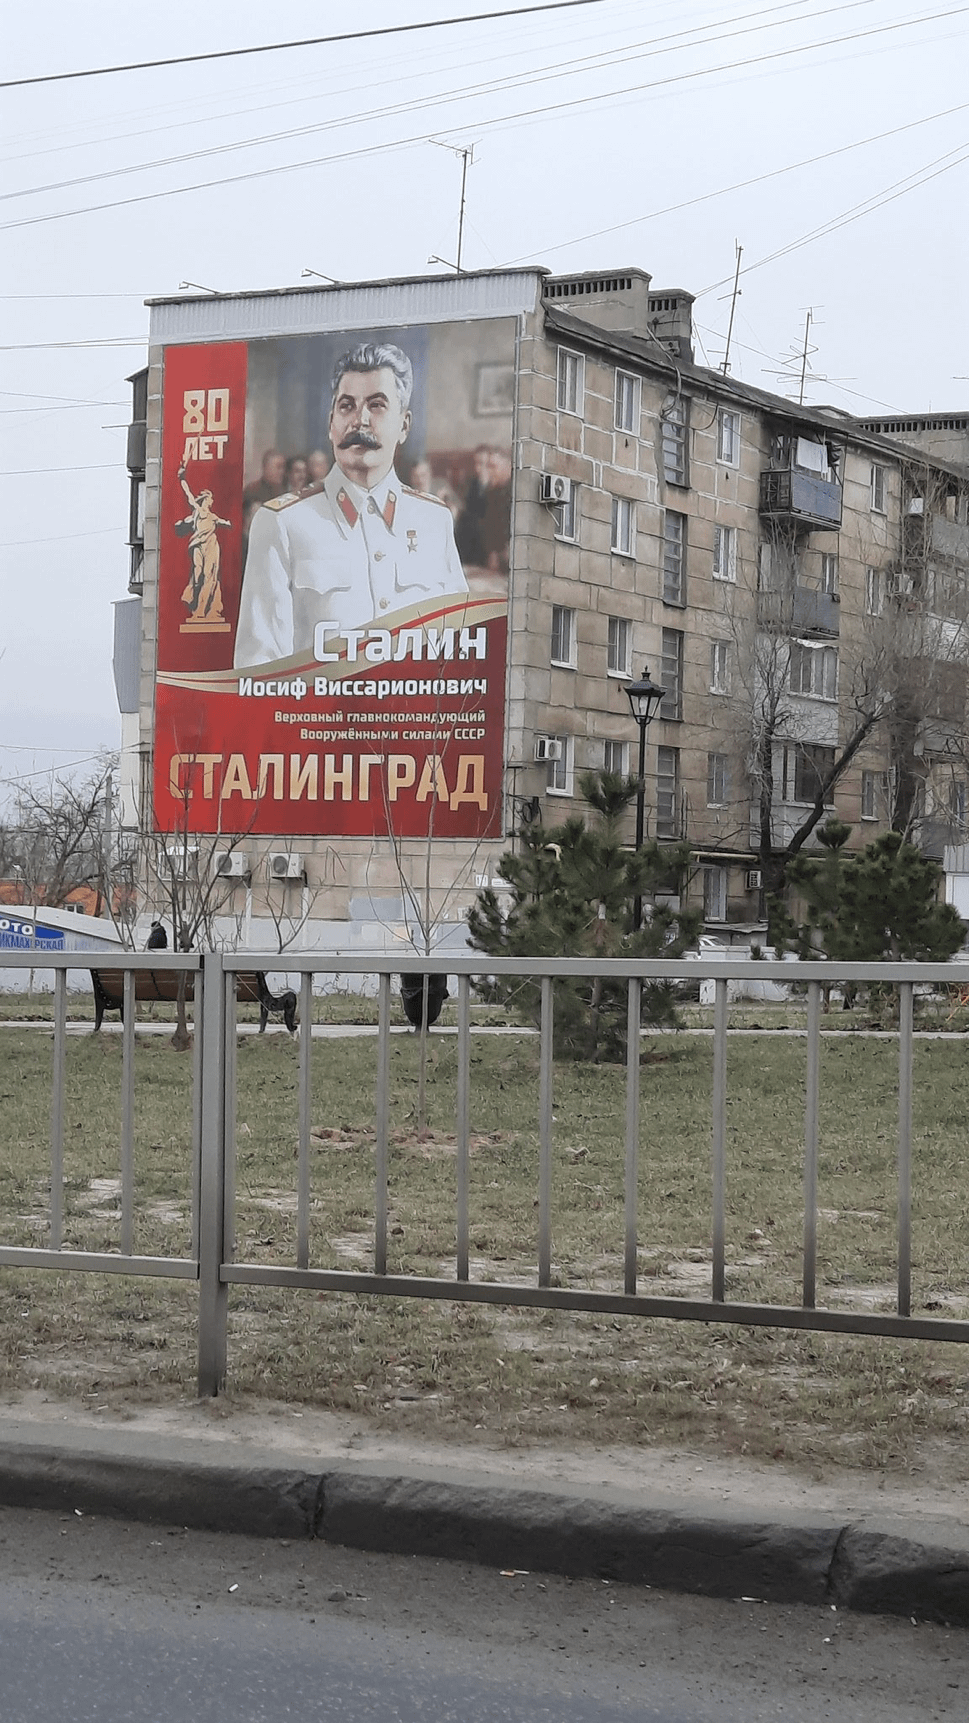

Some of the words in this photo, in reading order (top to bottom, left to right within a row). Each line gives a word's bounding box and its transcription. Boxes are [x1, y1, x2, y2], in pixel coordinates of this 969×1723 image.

[182, 388, 230, 433] 80
[182, 435, 229, 461] ЛЕТ
[314, 621, 487, 662] Сталин
[238, 676, 307, 701] Иосиф
[314, 676, 487, 699] Виссарионович
[274, 710, 343, 725] Верховный
[346, 710, 486, 724] главнокомандующий
[300, 728, 399, 742] Вооружёнными
[402, 730, 451, 740] силами
[454, 728, 486, 740] СССР
[169, 753, 488, 811] СТАЛИНГРАД
